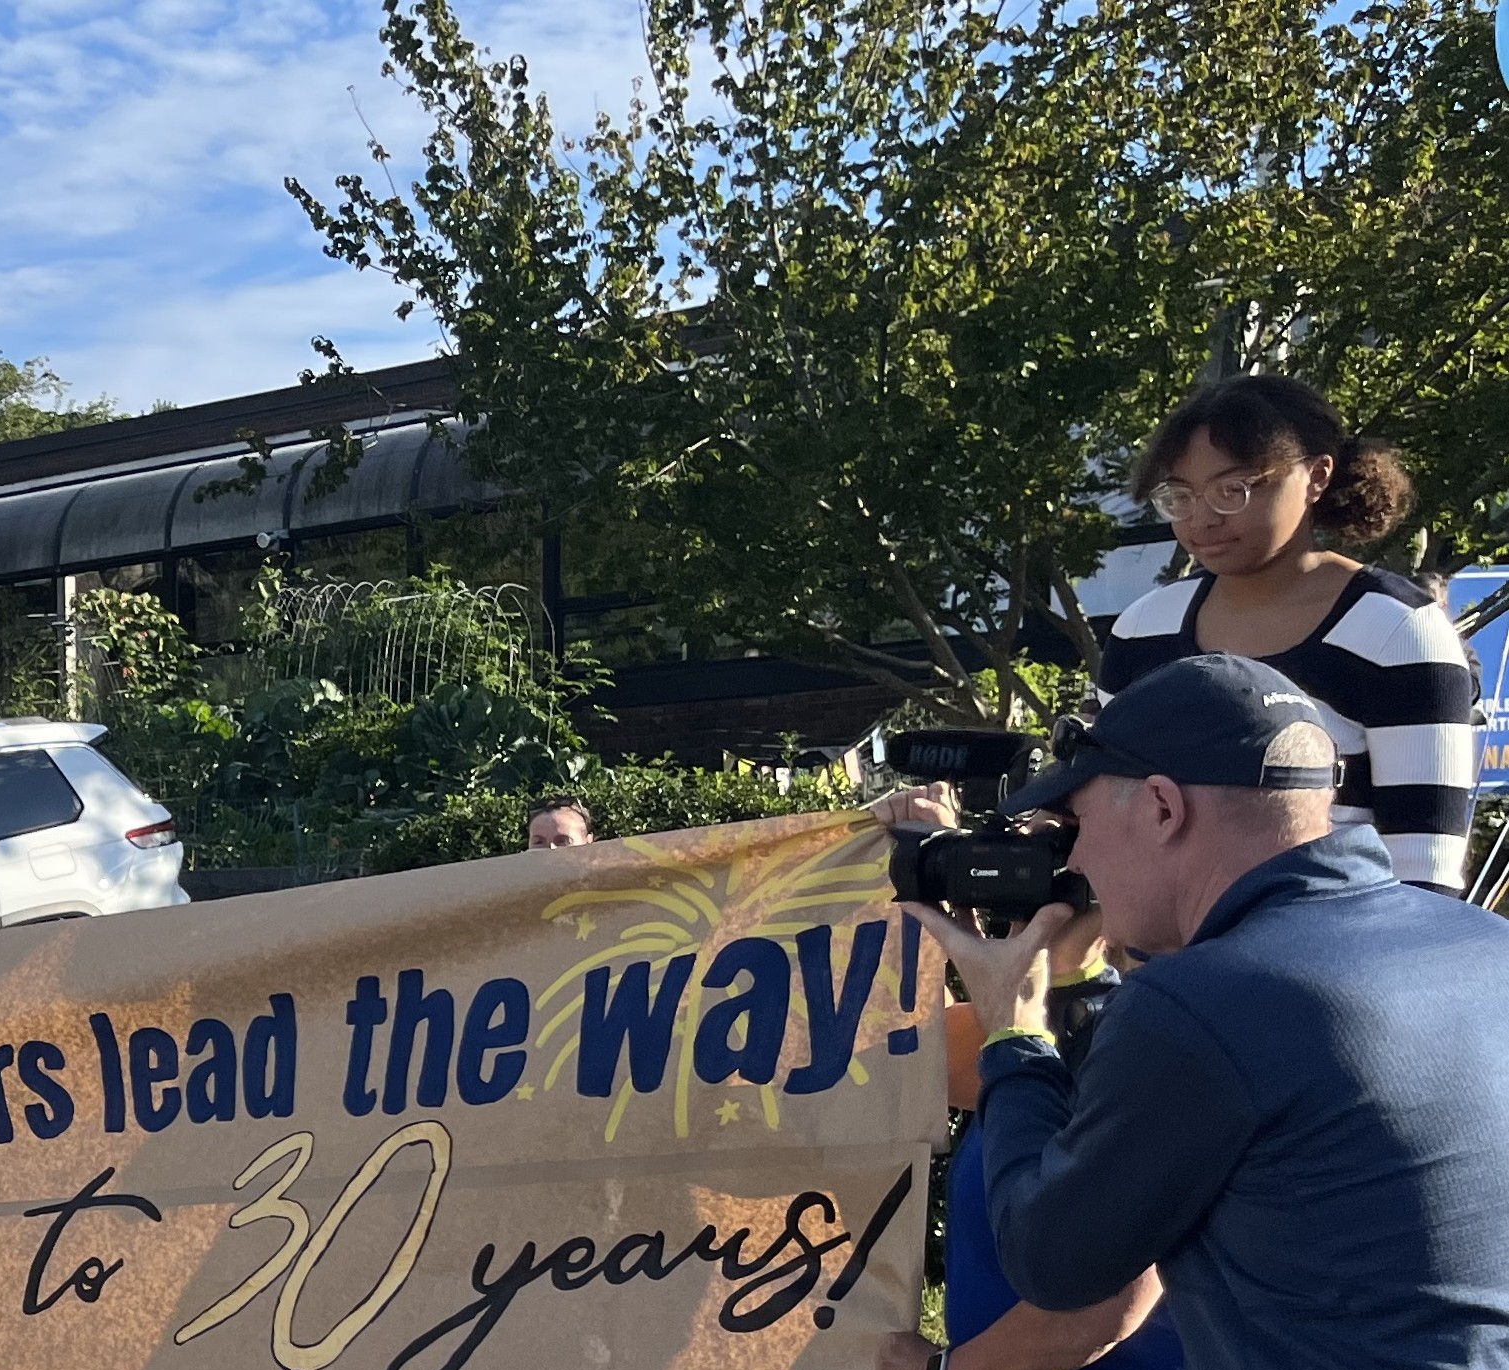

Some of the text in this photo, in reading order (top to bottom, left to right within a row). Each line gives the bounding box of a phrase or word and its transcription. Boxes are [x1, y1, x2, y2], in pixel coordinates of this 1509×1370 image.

[89, 993, 298, 1133] lead
[342, 968, 531, 1117] the
[576, 911, 920, 1098] way!
[22, 1166, 163, 1316] to
